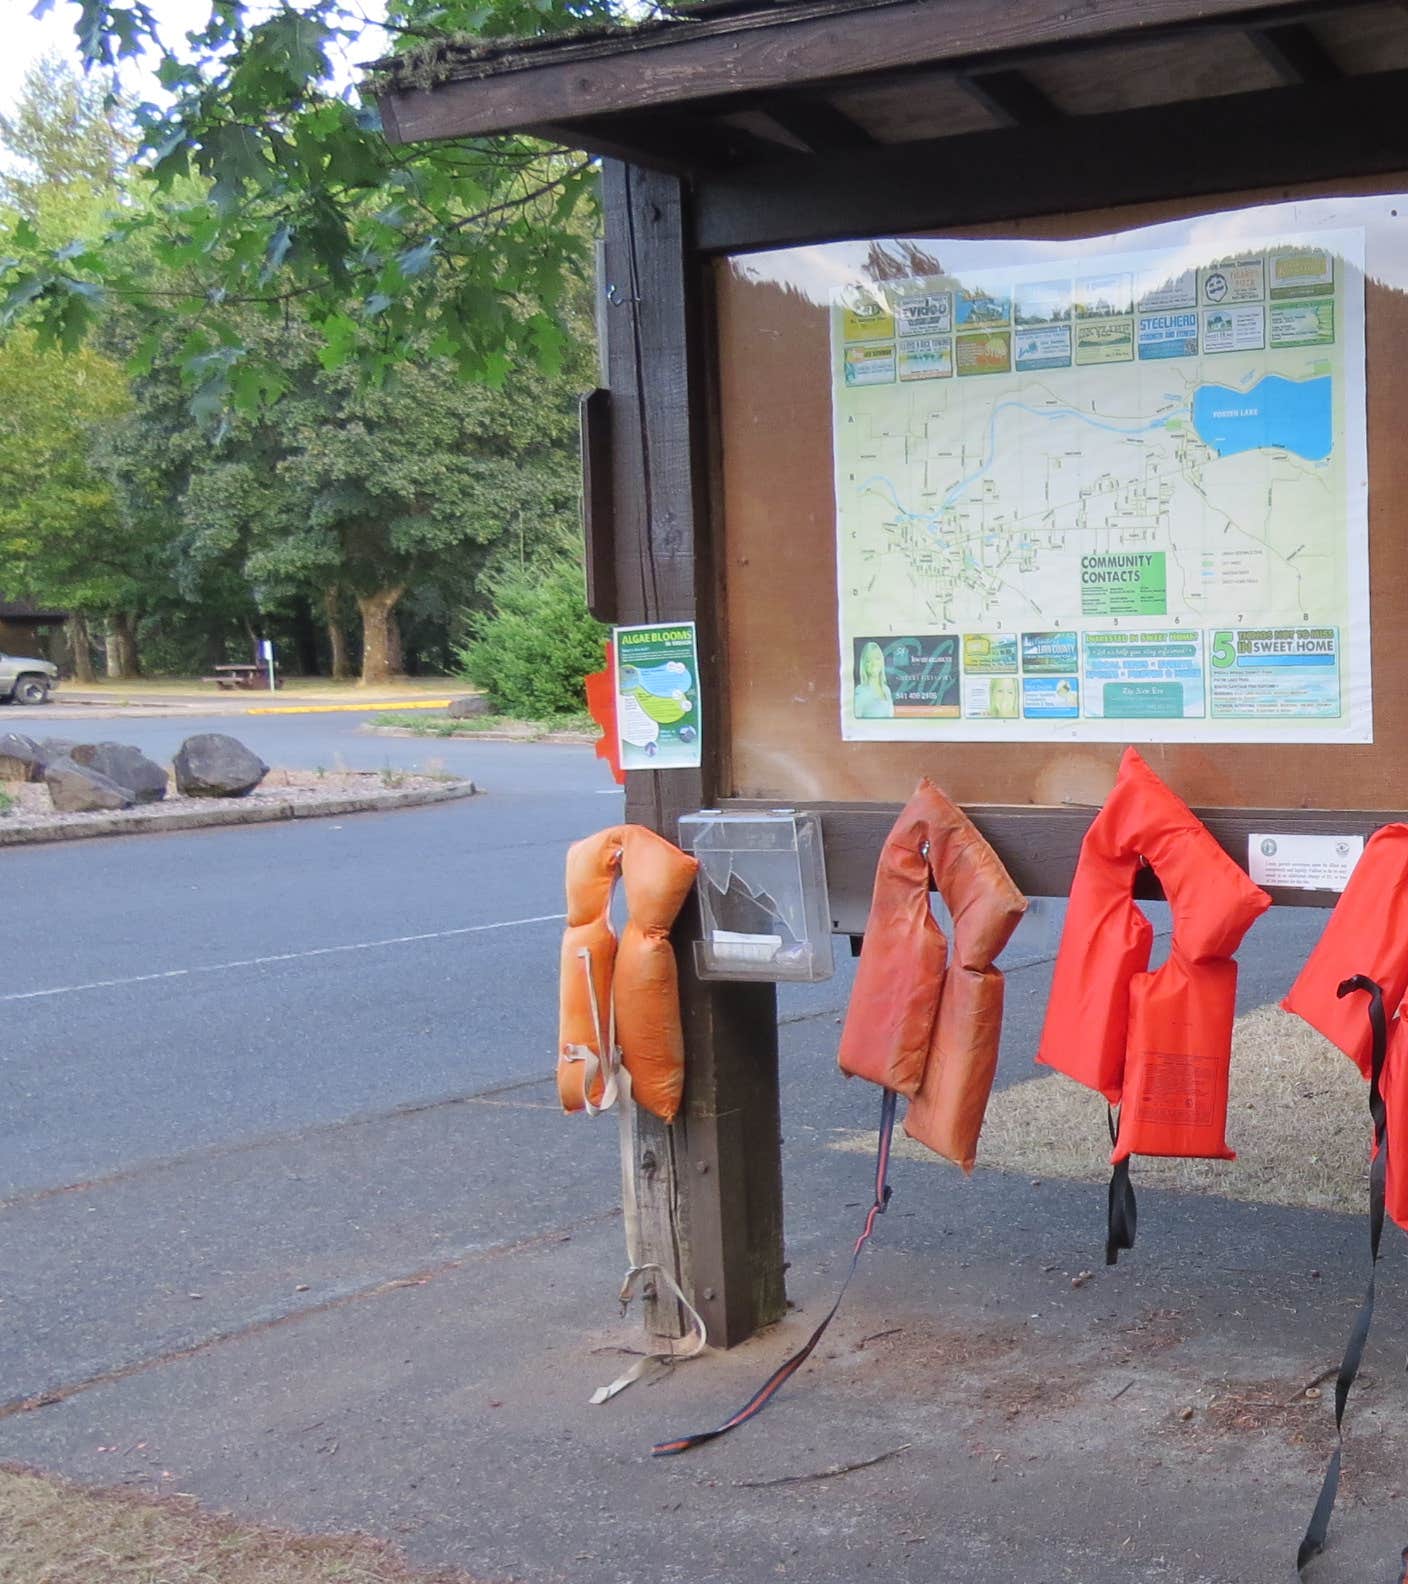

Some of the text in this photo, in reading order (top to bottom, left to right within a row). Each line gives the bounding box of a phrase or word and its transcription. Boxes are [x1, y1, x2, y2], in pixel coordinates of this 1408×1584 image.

[1240, 408, 1259, 417] LAKE
[1080, 555, 1153, 569] COMMUNITY
[1081, 570, 1141, 584] CONTACTS
[1174, 616, 1180, 624] 6
[1237, 614, 1243, 622] 7
[622, 630, 692, 646] ALGAE BLOOMS
[1296, 629, 1311, 639] TO
[1212, 631, 1236, 668] 5
[1237, 640, 1334, 653] IN SWEET HOME
